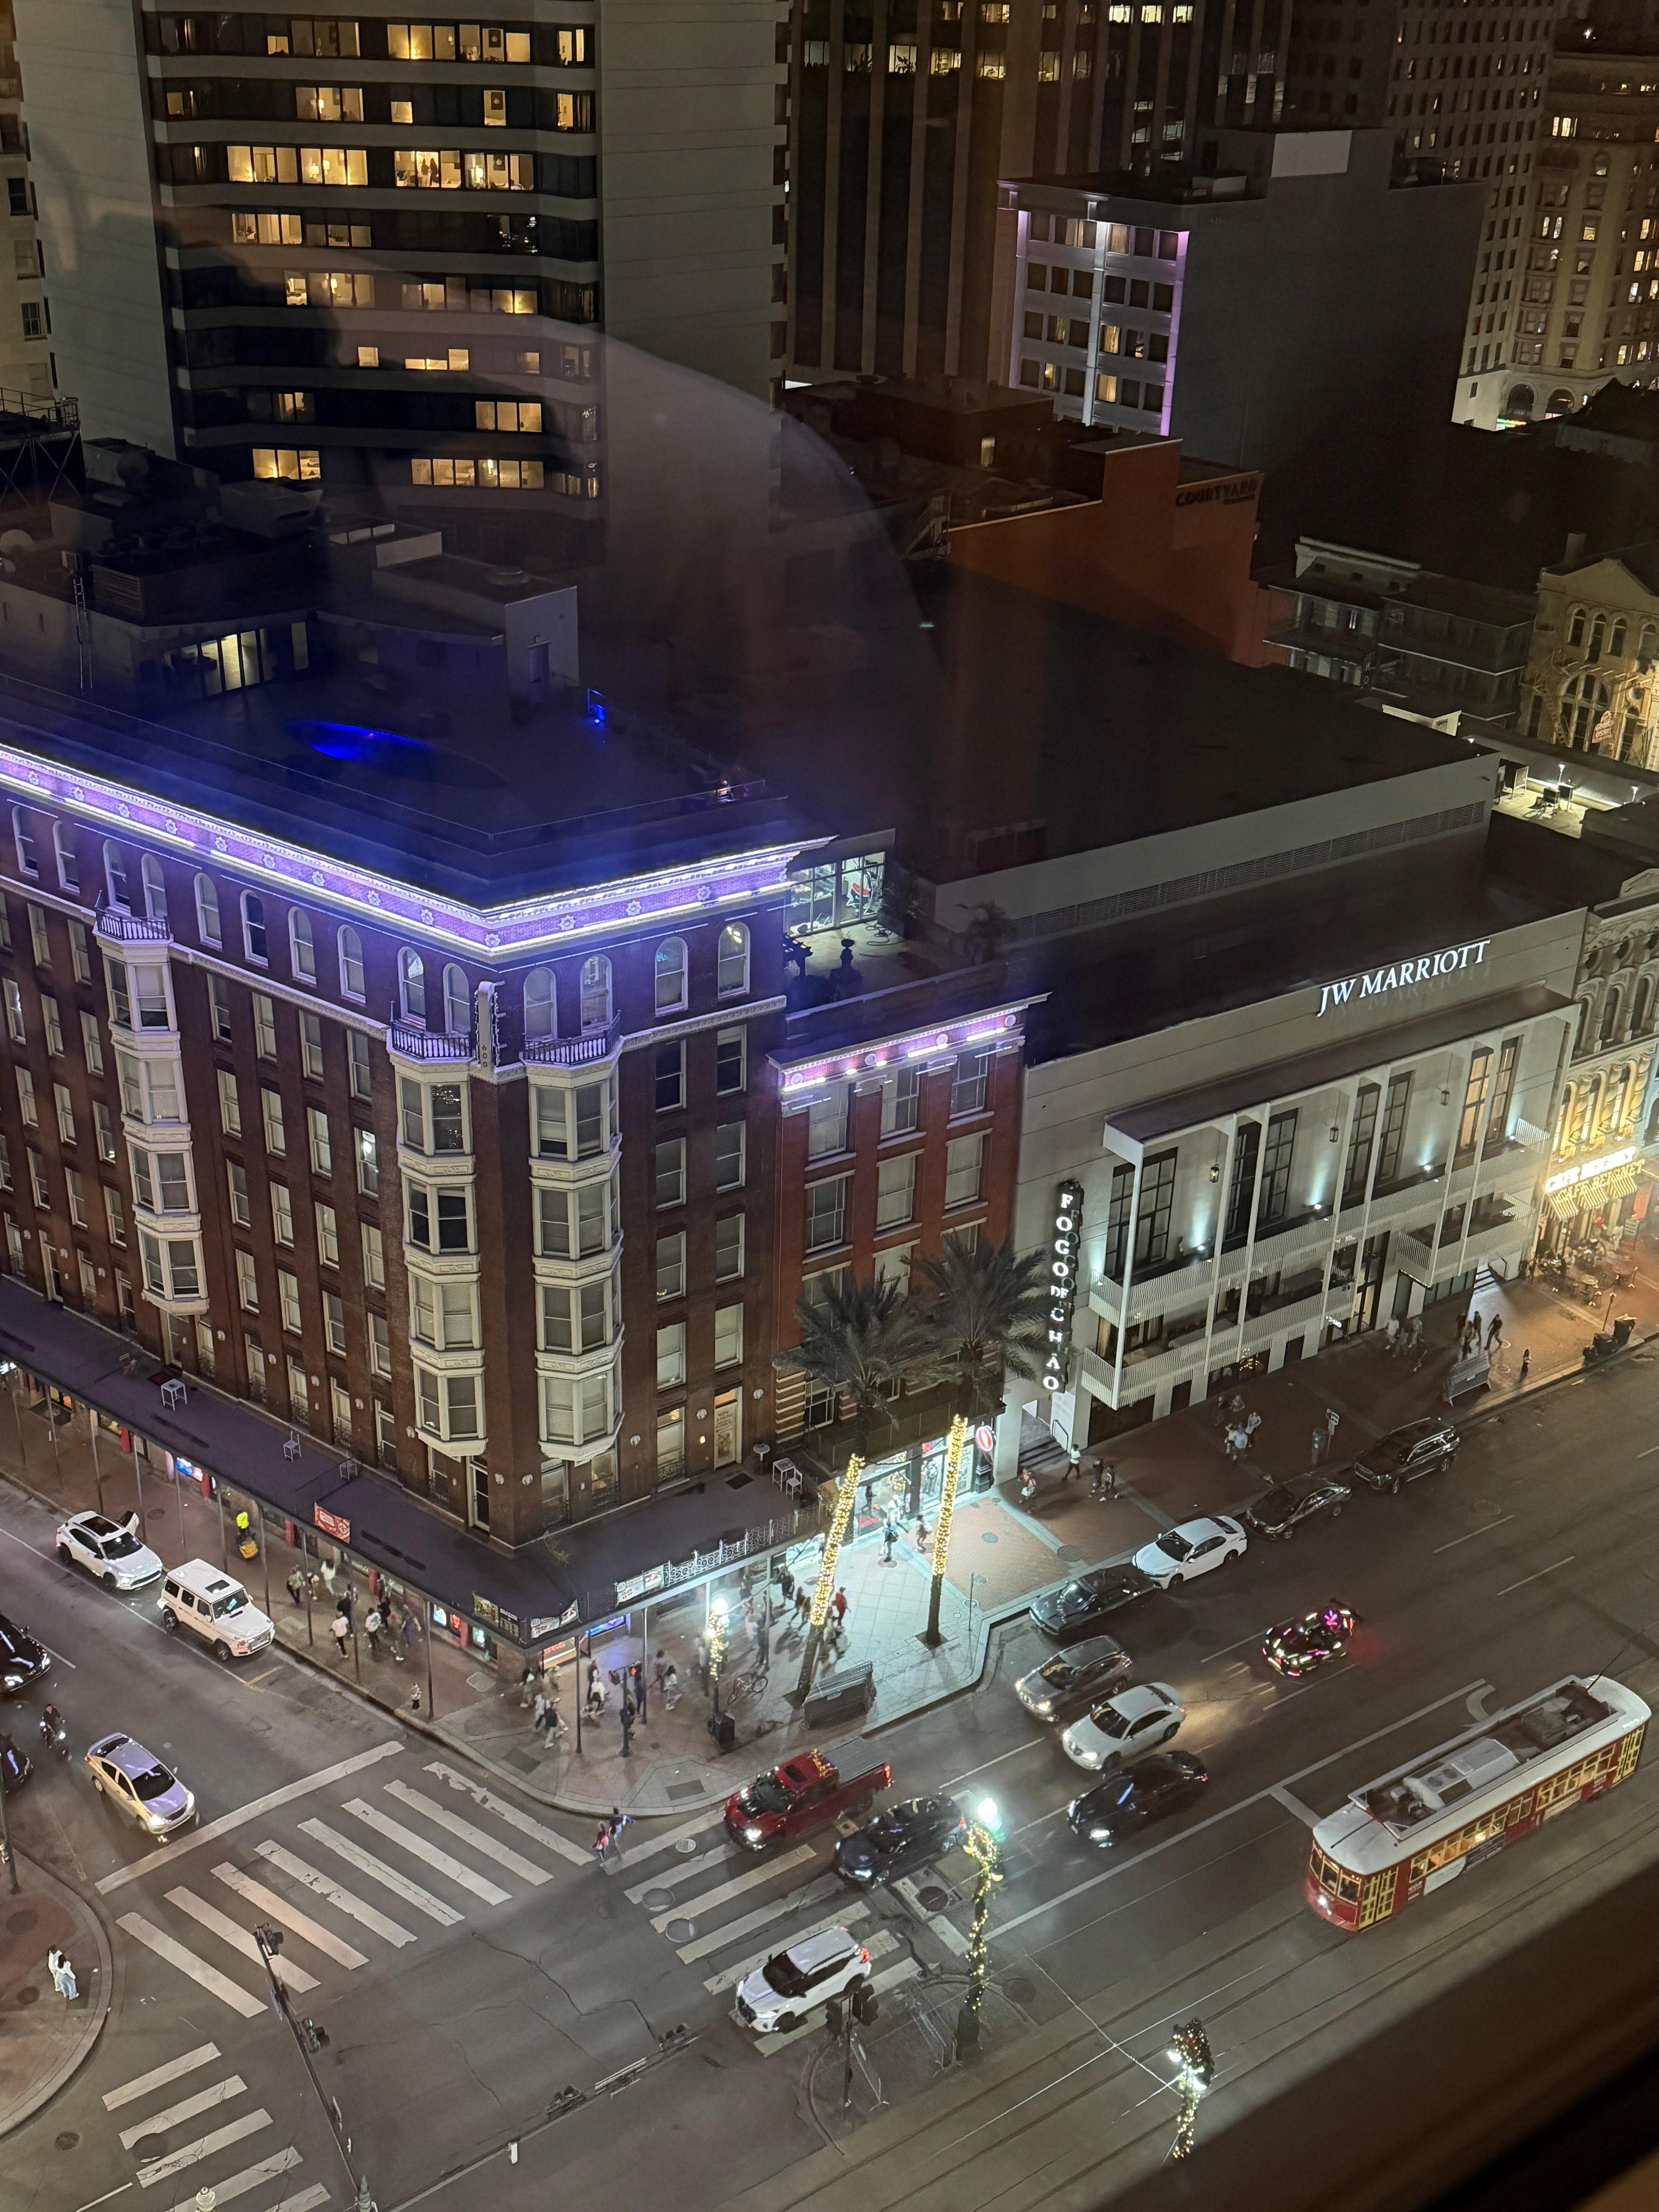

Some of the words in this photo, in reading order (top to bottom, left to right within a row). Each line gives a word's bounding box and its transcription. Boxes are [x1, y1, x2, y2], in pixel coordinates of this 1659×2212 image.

[1317, 979, 1357, 1017] JW
[1359, 940, 1491, 998] MARRIOTT
[1052, 1193, 1073, 1277] FOGO
[1050, 1285, 1069, 1298] DE
